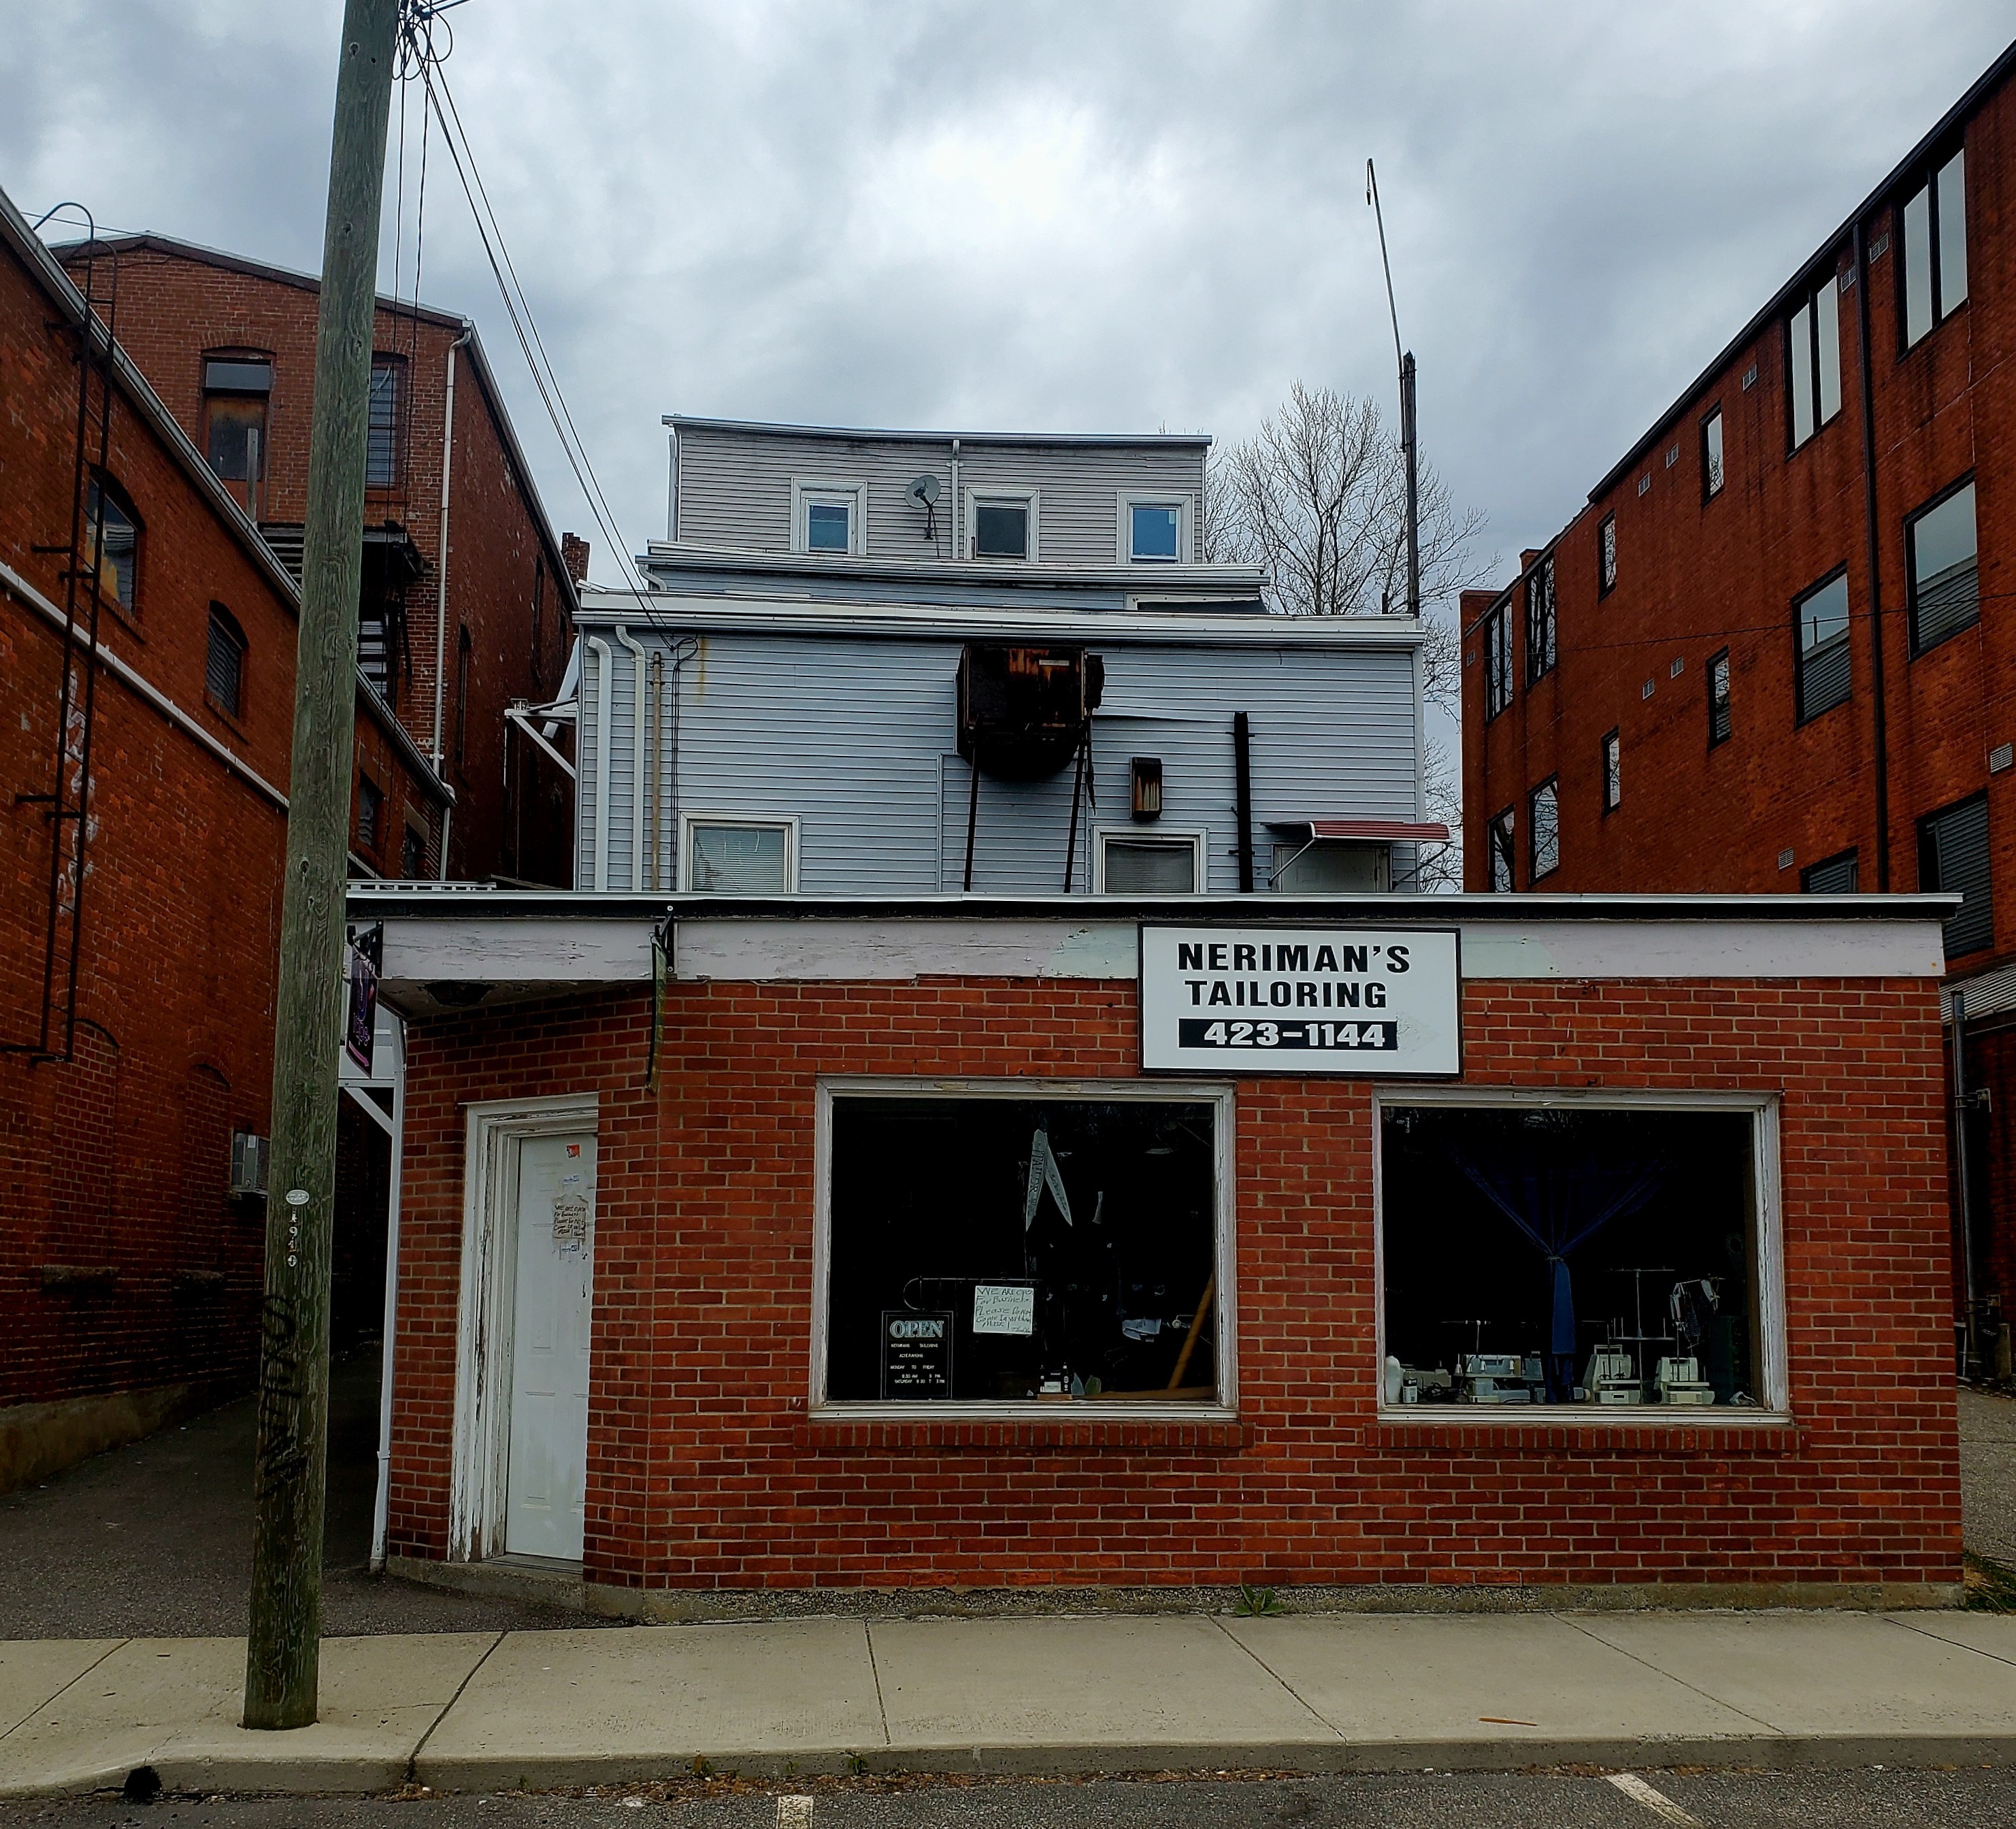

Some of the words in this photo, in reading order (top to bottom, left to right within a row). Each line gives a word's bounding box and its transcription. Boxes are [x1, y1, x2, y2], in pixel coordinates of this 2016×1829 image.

[1178, 942, 1410, 973] NERIMAN'S
[1184, 980, 1387, 1008] TAILORING
[1203, 1022, 1385, 1048] 423-1144
[889, 1320, 944, 1338] OPEN
